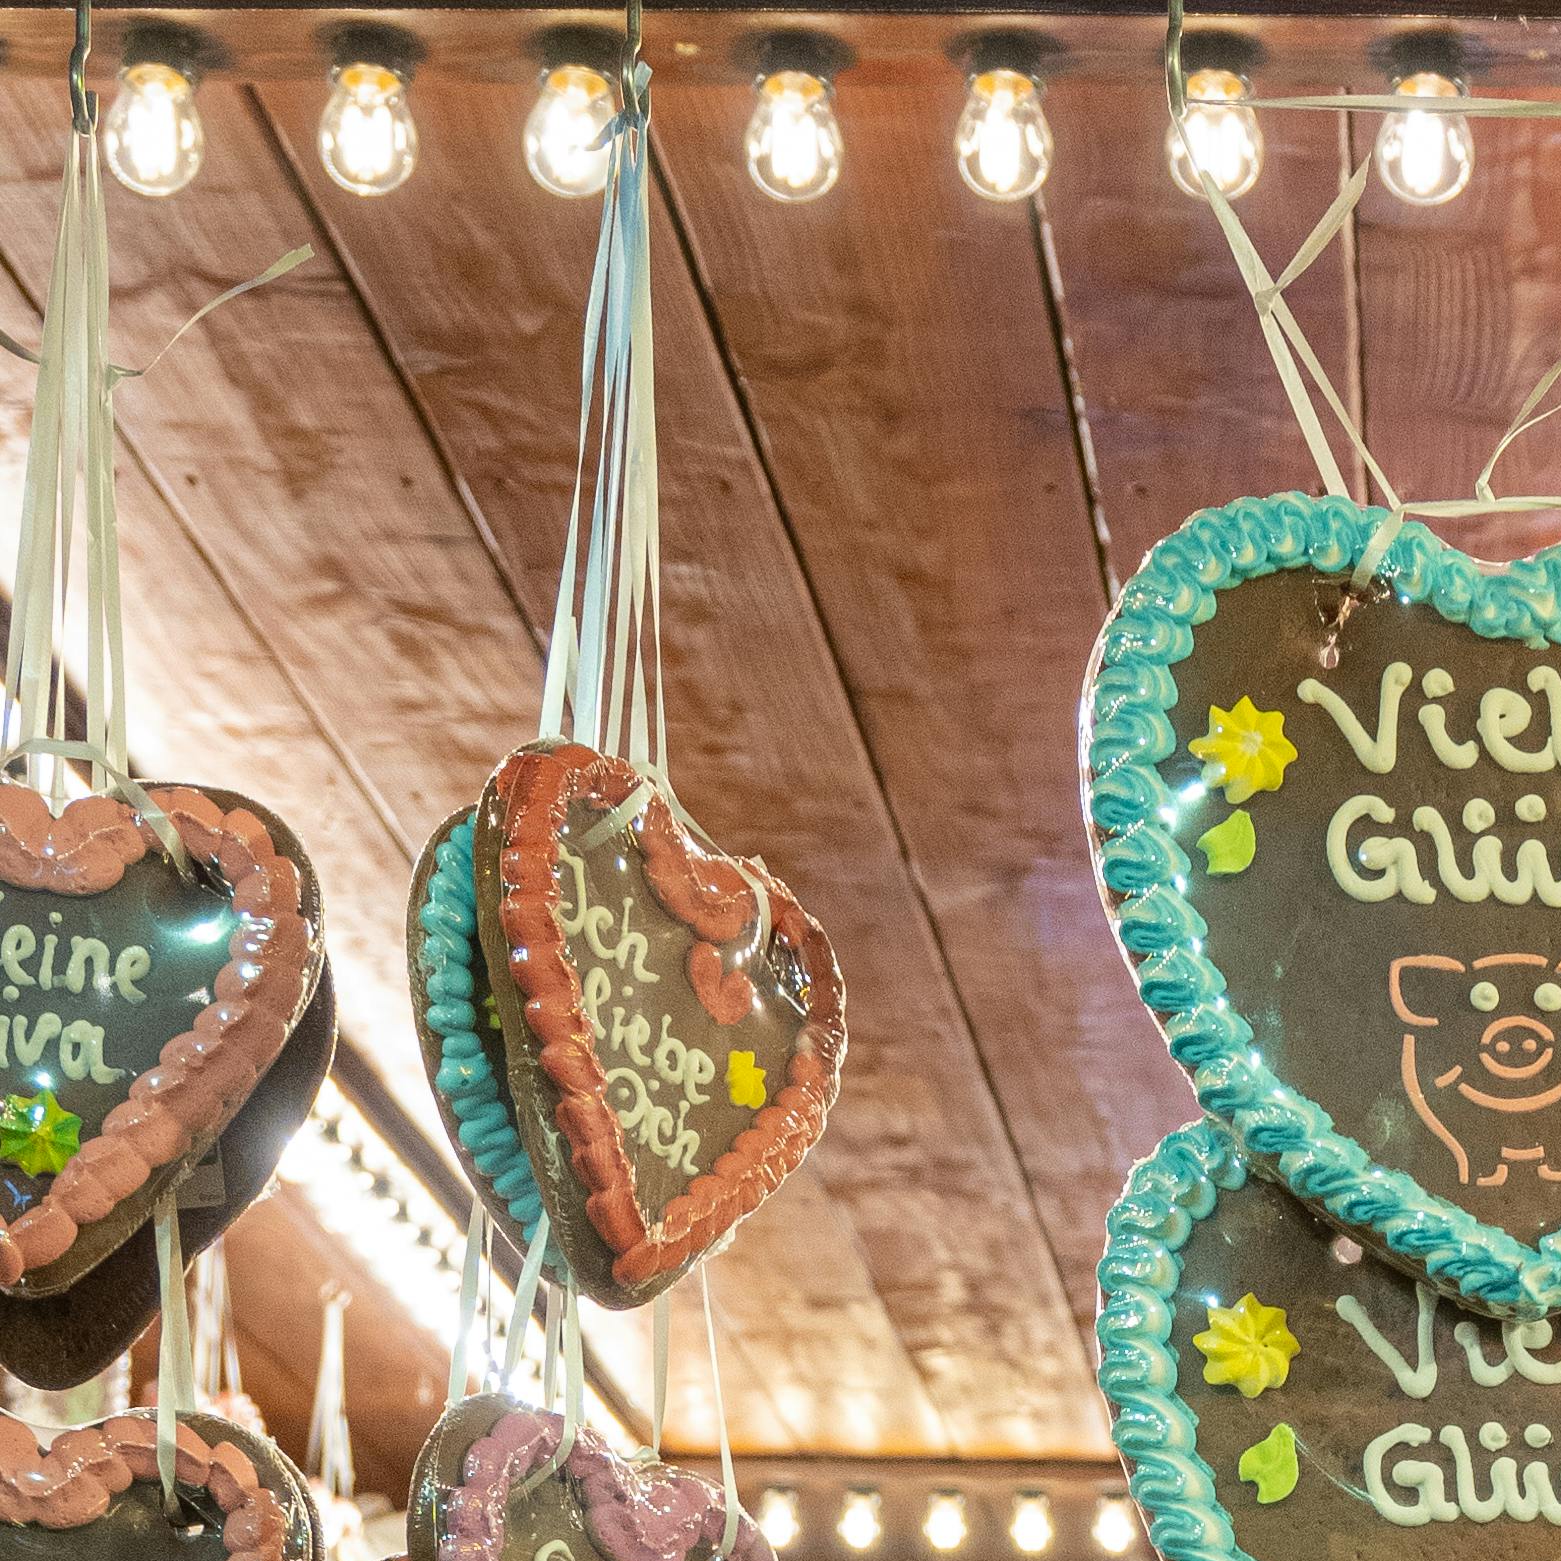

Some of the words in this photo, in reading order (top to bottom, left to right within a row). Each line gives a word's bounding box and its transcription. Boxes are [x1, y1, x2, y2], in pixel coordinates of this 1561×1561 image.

[0, 911, 151, 1003] eine
[553, 843, 660, 983] Ich
[0, 985, 127, 1084] iva
[581, 967, 716, 1104] liebe
[605, 1067, 700, 1176] Dich
